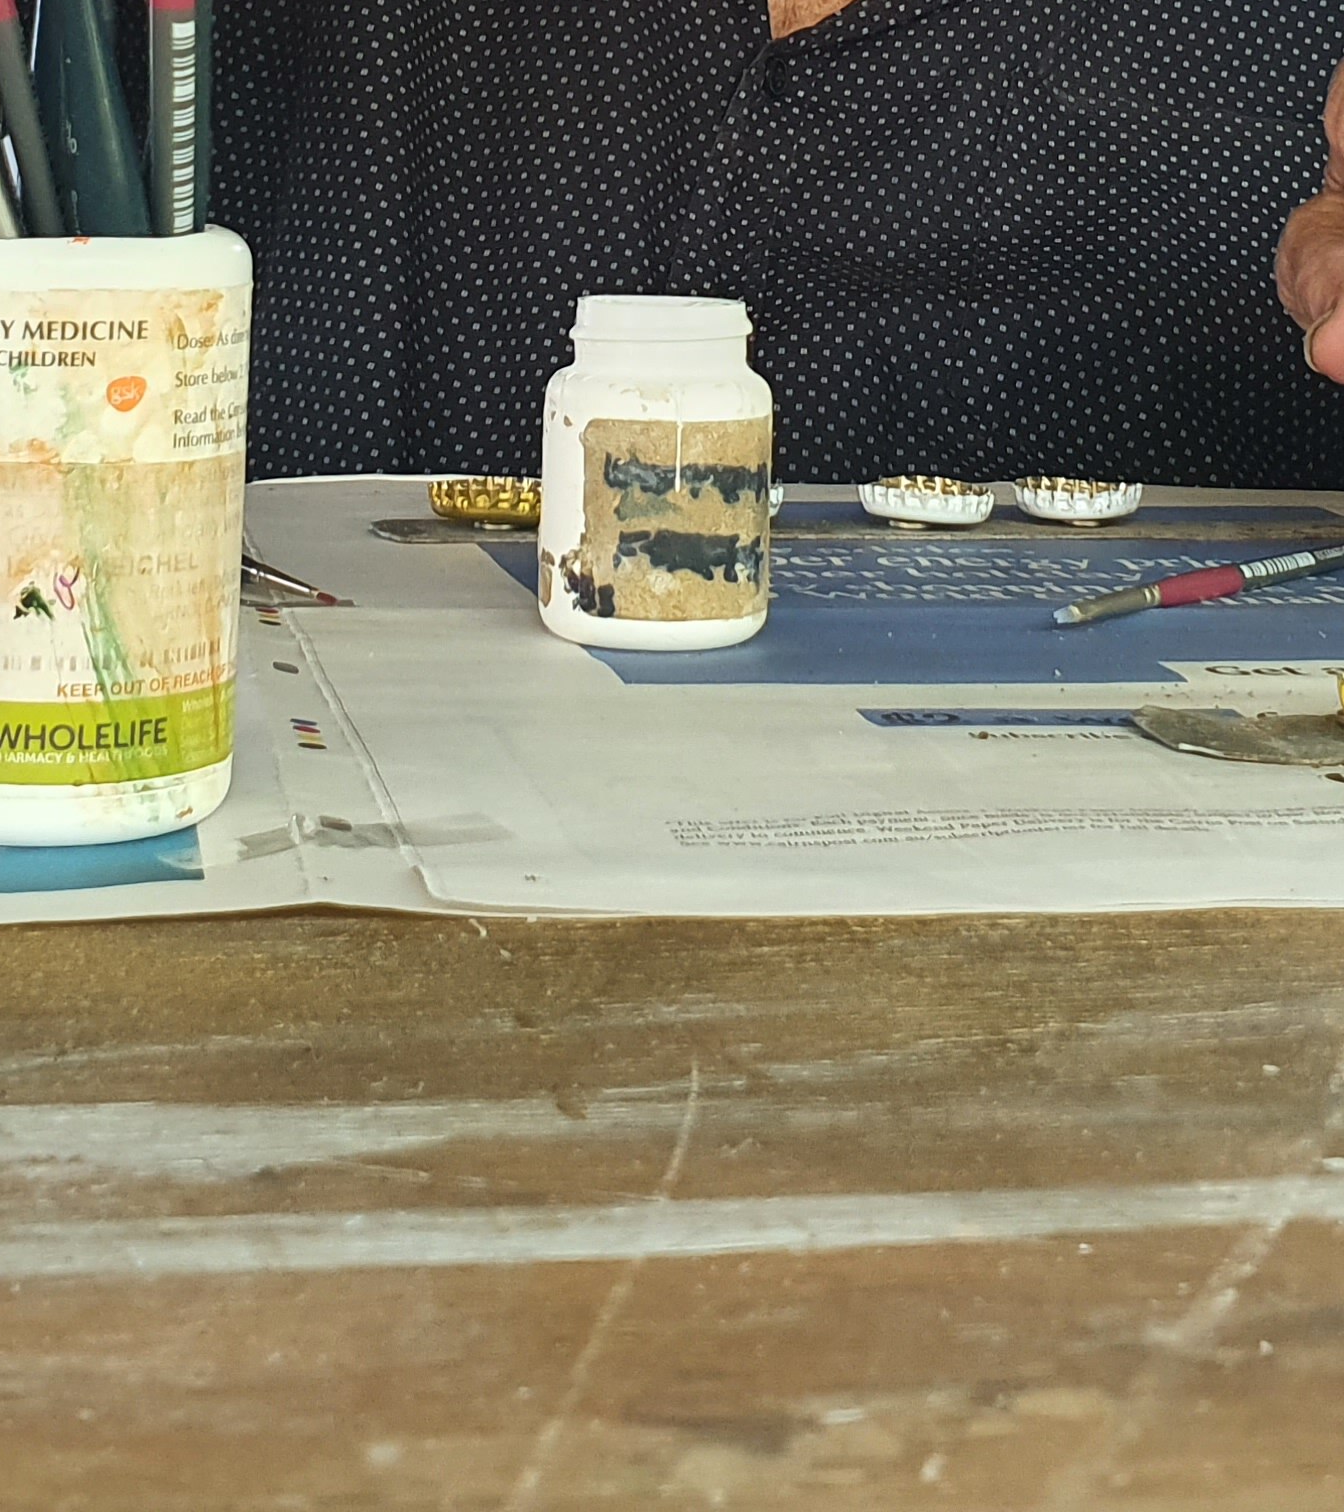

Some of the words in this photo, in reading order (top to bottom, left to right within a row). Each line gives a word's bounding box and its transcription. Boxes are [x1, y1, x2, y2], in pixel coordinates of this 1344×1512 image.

[22, 319, 149, 341] MEDICINE
[216, 331, 229, 346] As
[175, 371, 208, 388] Store
[111, 380, 143, 405] gsk
[174, 405, 207, 425] Read
[210, 402, 226, 422] the
[172, 428, 235, 449] Information
[876, 555, 1089, 570] energy
[1115, 555, 1244, 571] pric
[1204, 664, 1306, 676] Get
[110, 679, 145, 696] OUT
[149, 675, 169, 692] OF
[66, 751, 75, 764] &
